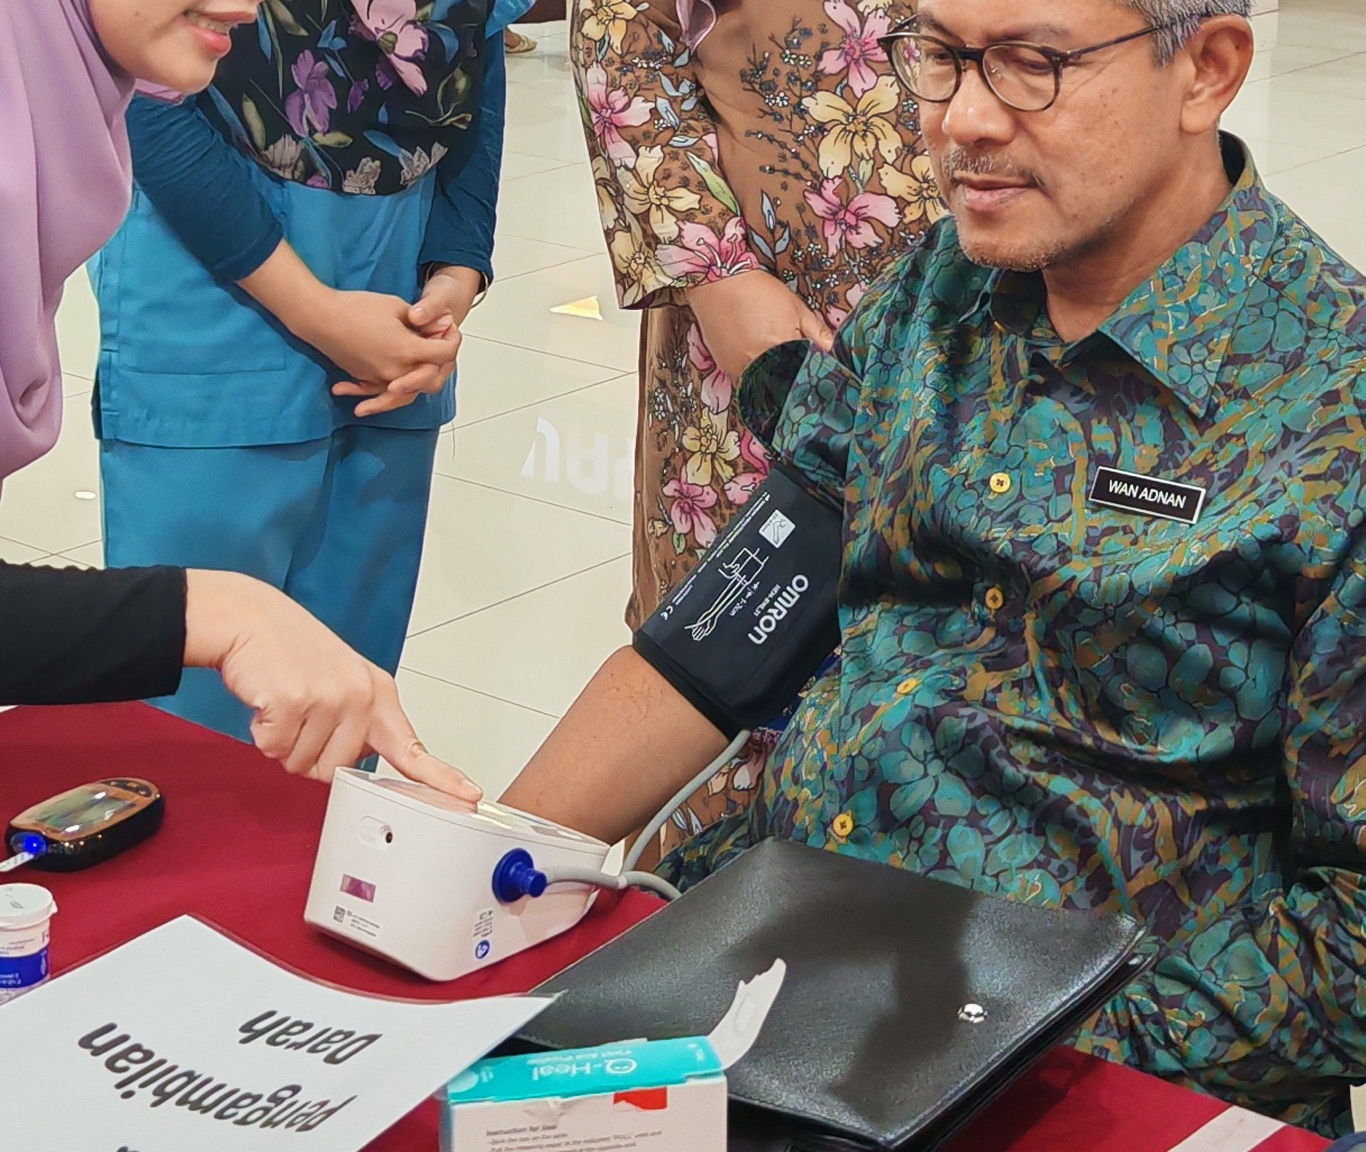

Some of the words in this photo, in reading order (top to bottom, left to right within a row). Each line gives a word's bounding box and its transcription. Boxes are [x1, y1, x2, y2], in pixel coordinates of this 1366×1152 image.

[1108, 479, 1139, 498] WAN
[1139, 487, 1187, 509] ADNAN
[238, 1009, 383, 1065] Darah
[77, 1022, 359, 1133] pengambilan
